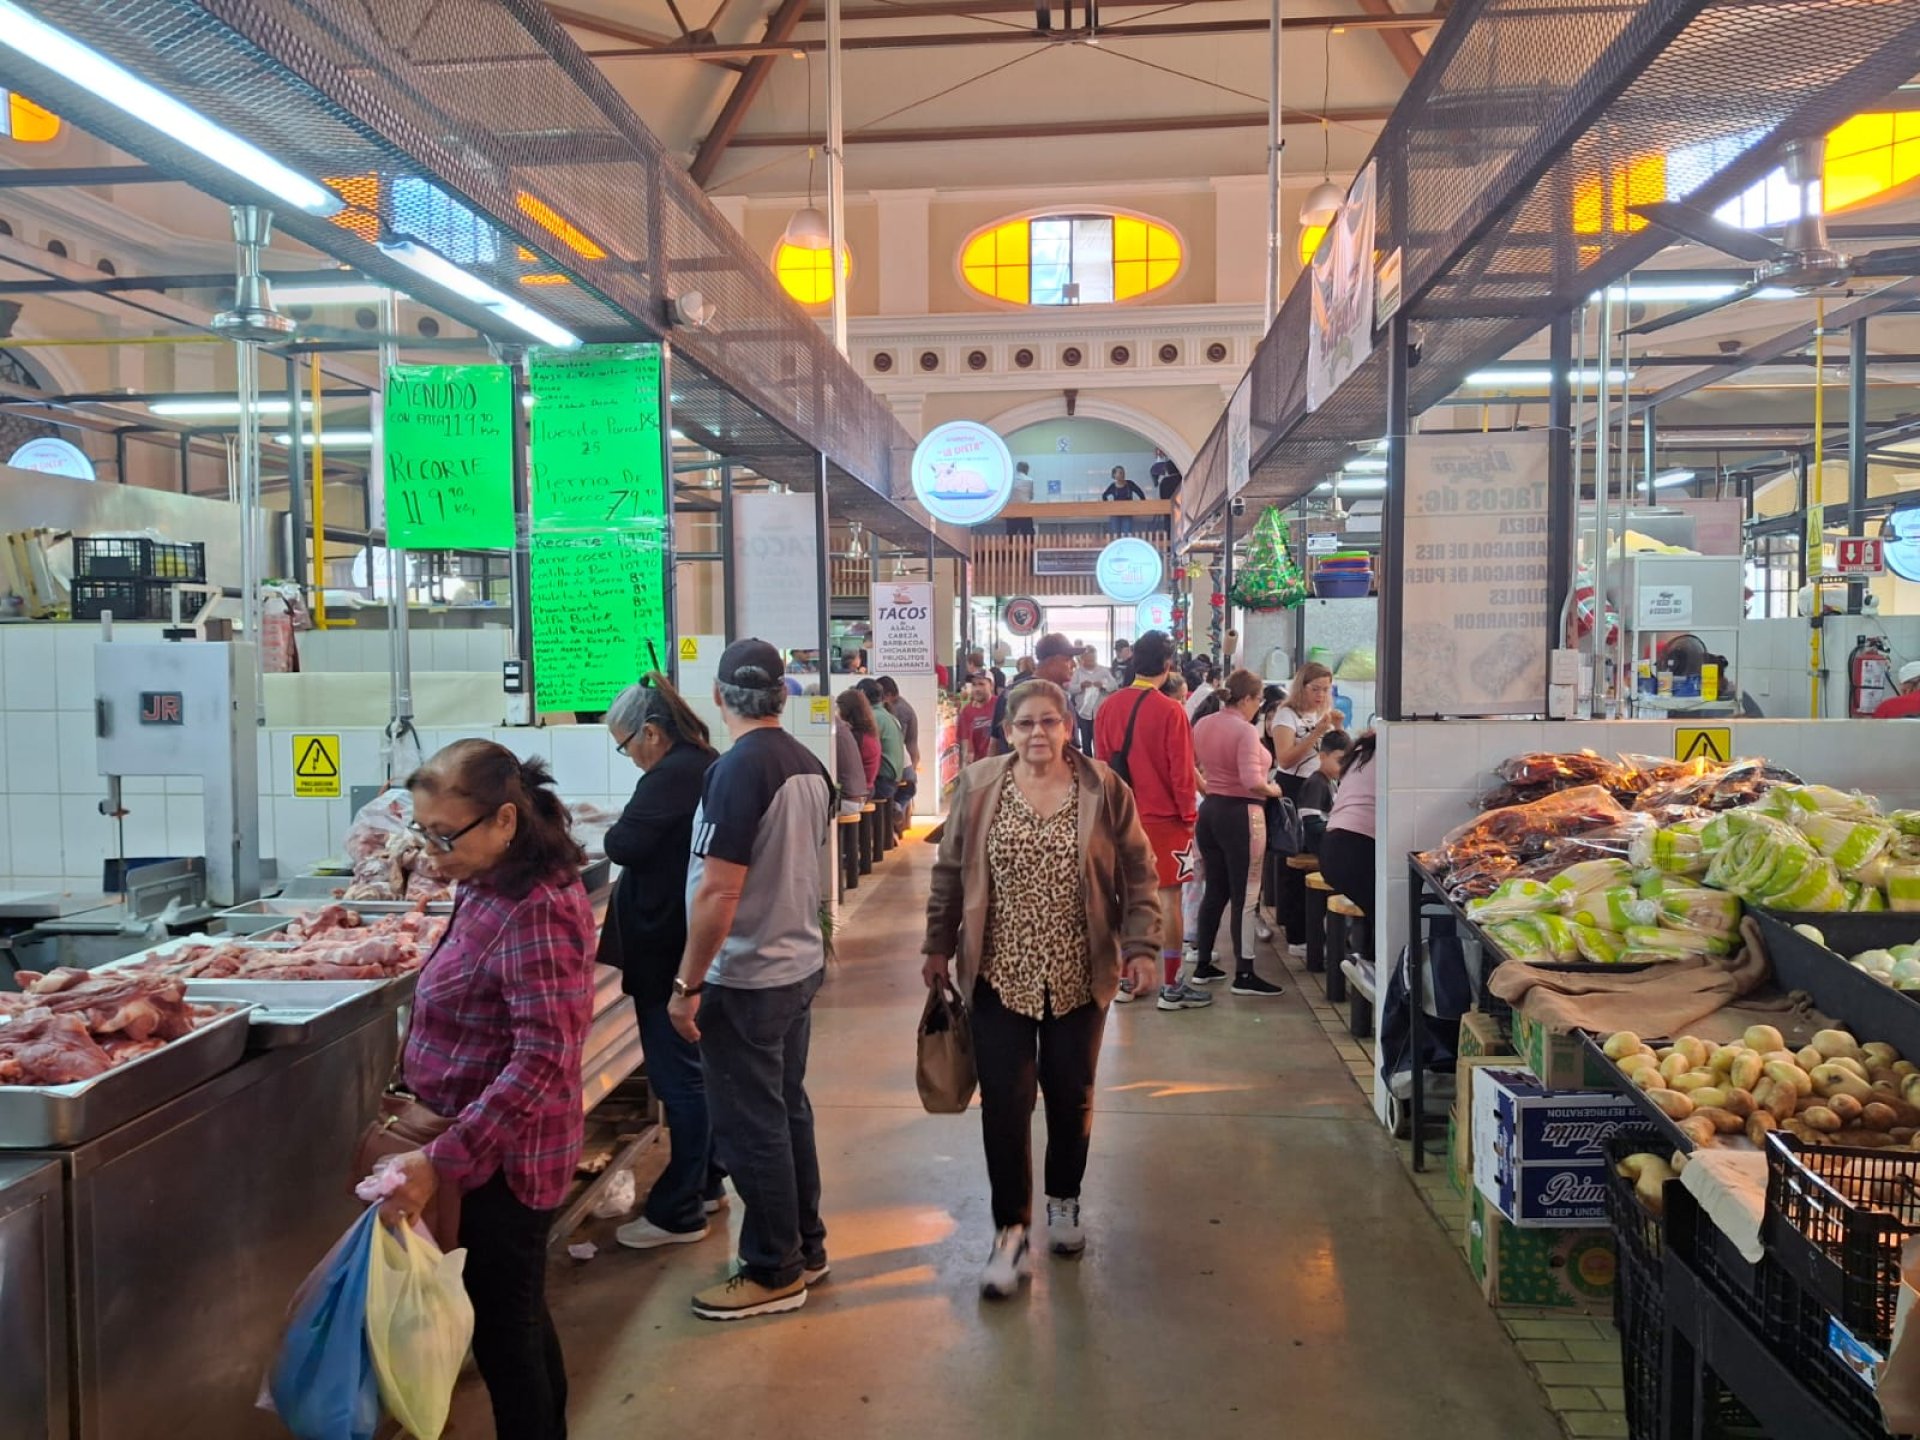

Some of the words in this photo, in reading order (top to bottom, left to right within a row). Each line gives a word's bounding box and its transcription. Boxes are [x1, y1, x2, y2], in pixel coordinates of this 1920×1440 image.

[388, 374, 477, 409] MENUDO
[390, 413, 410, 423] CON
[444, 414, 475, 437] 119
[581, 441, 600, 455] 25
[389, 452, 489, 485] RECORTE
[534, 462, 609, 493] Pierna
[402, 487, 445, 526] 119
[607, 489, 639, 521] 79
[878, 606, 928, 620] TACOS
[144, 696, 177, 720] JR
[1547, 1108, 1626, 1118] REFRIGERATION
[1538, 1171, 1606, 1206] Prim
[1546, 1208, 1572, 1217] KEEP
[1574, 1208, 1605, 1217] UNDE
